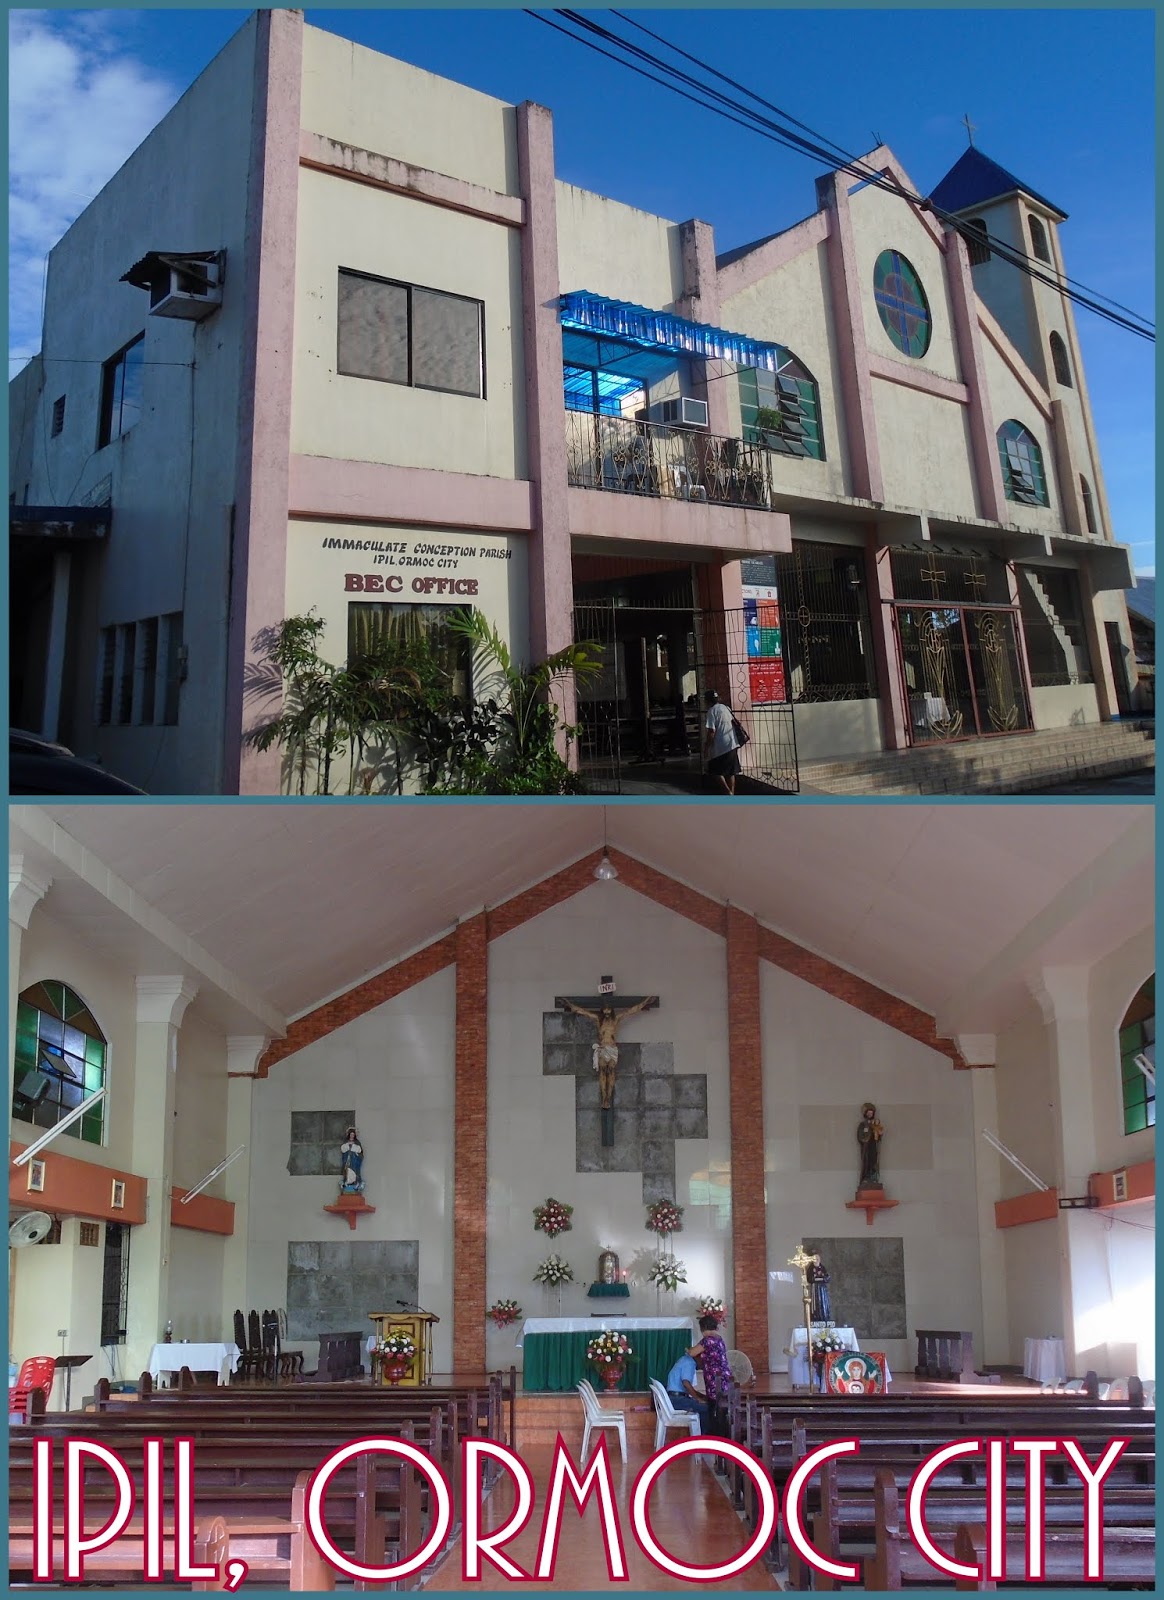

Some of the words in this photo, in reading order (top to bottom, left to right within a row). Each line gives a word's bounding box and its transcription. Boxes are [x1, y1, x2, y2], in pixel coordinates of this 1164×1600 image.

[322, 537, 407, 553] IMMACULATE
[413, 543, 476, 558] CONCEPTION
[479, 547, 512, 560] PARISH
[437, 558, 459, 569] CITY
[344, 573, 403, 593] BEC
[411, 577, 479, 596] OFFICE
[599, 983, 614, 993] INRI
